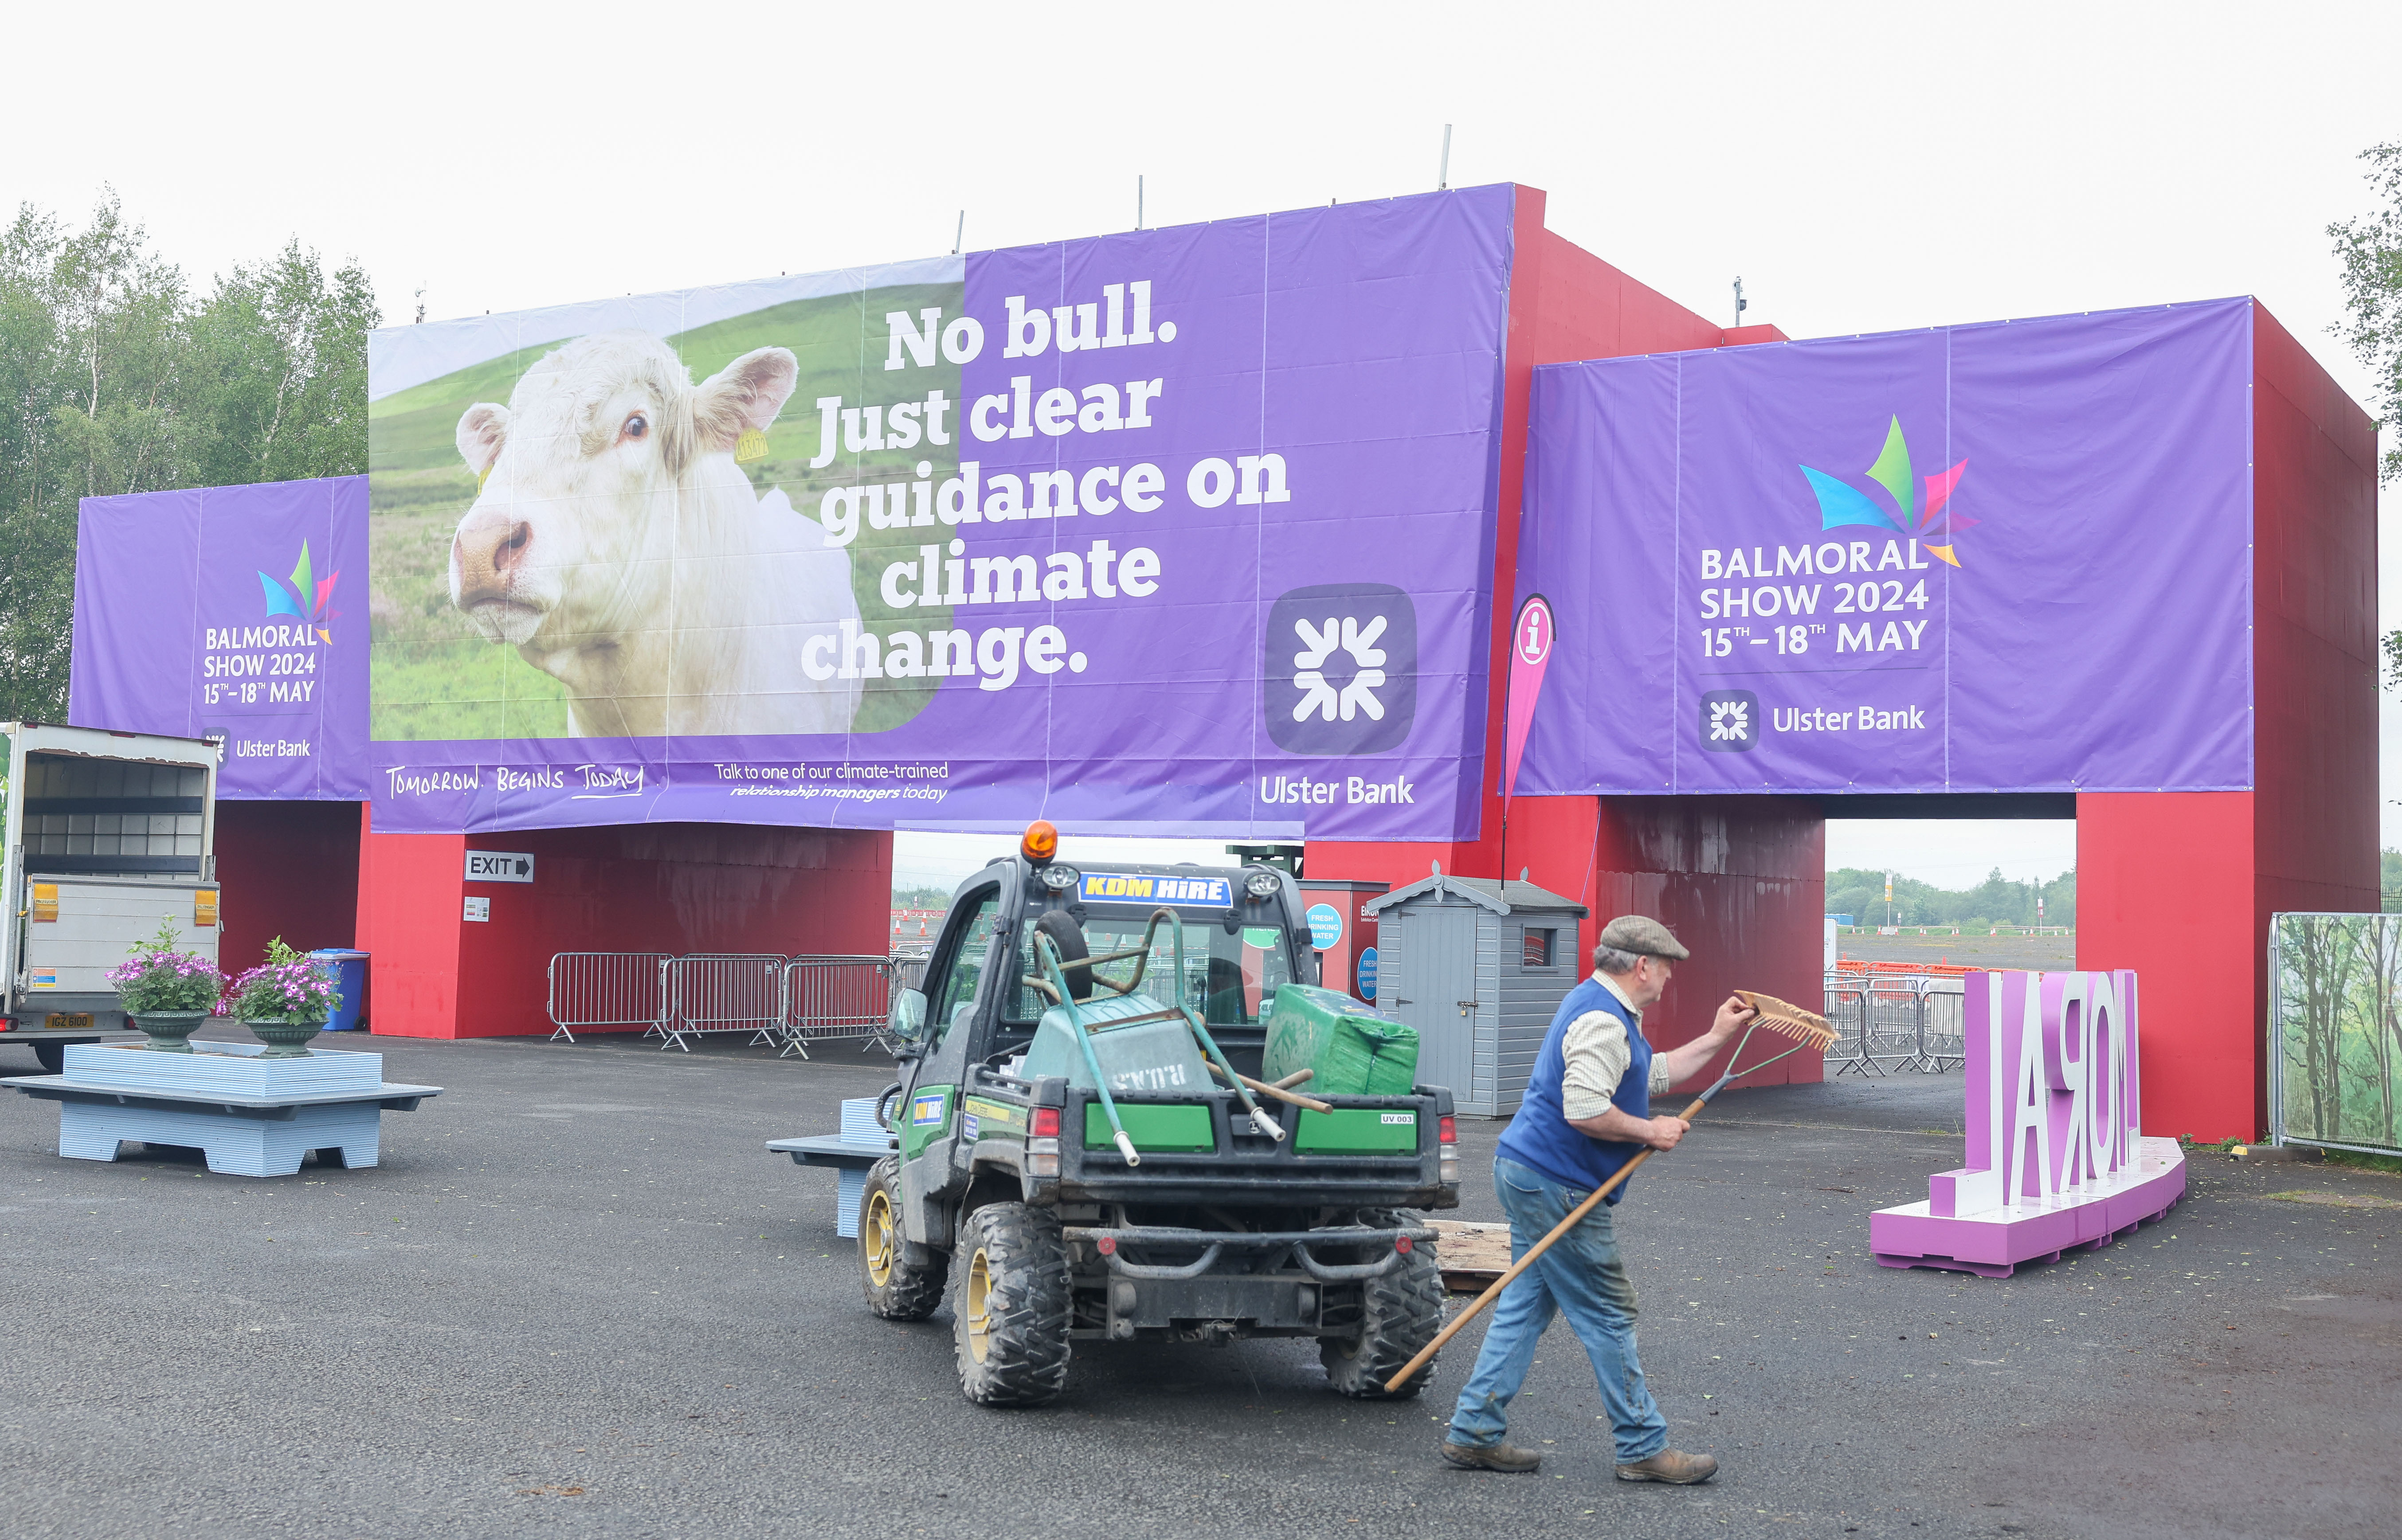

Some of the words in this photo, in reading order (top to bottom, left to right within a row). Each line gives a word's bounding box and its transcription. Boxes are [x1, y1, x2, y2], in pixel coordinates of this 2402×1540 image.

[885, 307, 984, 371] No
[1003, 280, 1176, 359] bull.
[810, 390, 950, 469] Just
[970, 375, 1163, 442] clear
[737, 438, 767, 459] 413472
[819, 460, 1165, 548] guidance
[1187, 453, 1290, 508] on
[1701, 539, 1928, 579] BALMORAL
[881, 539, 1160, 608] climate
[1701, 584, 1822, 619] SHOW
[1834, 579, 1928, 613] 2024
[206, 624, 317, 649] BALMORAL
[1836, 620, 1928, 653] MAY
[204, 654, 265, 677] SHOW
[270, 653, 315, 675] 2024
[801, 619, 1088, 691] change.
[270, 681, 315, 702] MAY
[1774, 707, 1853, 731] Ulster
[1859, 705, 1925, 730] Bank
[237, 740, 275, 757] Ulster
[278, 739, 310, 756] Bank
[386, 763, 478, 799] TOMORROW
[497, 765, 563, 791] BEGINS
[575, 765, 643, 793] TODAY
[714, 764, 743, 779] Talk
[745, 766, 758, 779] to
[762, 768, 788, 779] one
[792, 763, 805, 778] of
[809, 767, 832, 778] our
[836, 762, 948, 778] climate-trained
[730, 785, 819, 799] relationship
[820, 786, 900, 803] managers
[903, 785, 948, 803] today
[1261, 776, 1339, 804] Ulster
[1348, 775, 1415, 804] Bank
[470, 857, 512, 875] EXIT
[1085, 877, 1153, 897] KDM
[52, 1017, 66, 1027] IGZ
[69, 1016, 87, 1026] 6100
[915, 1102, 927, 1120] KDM
